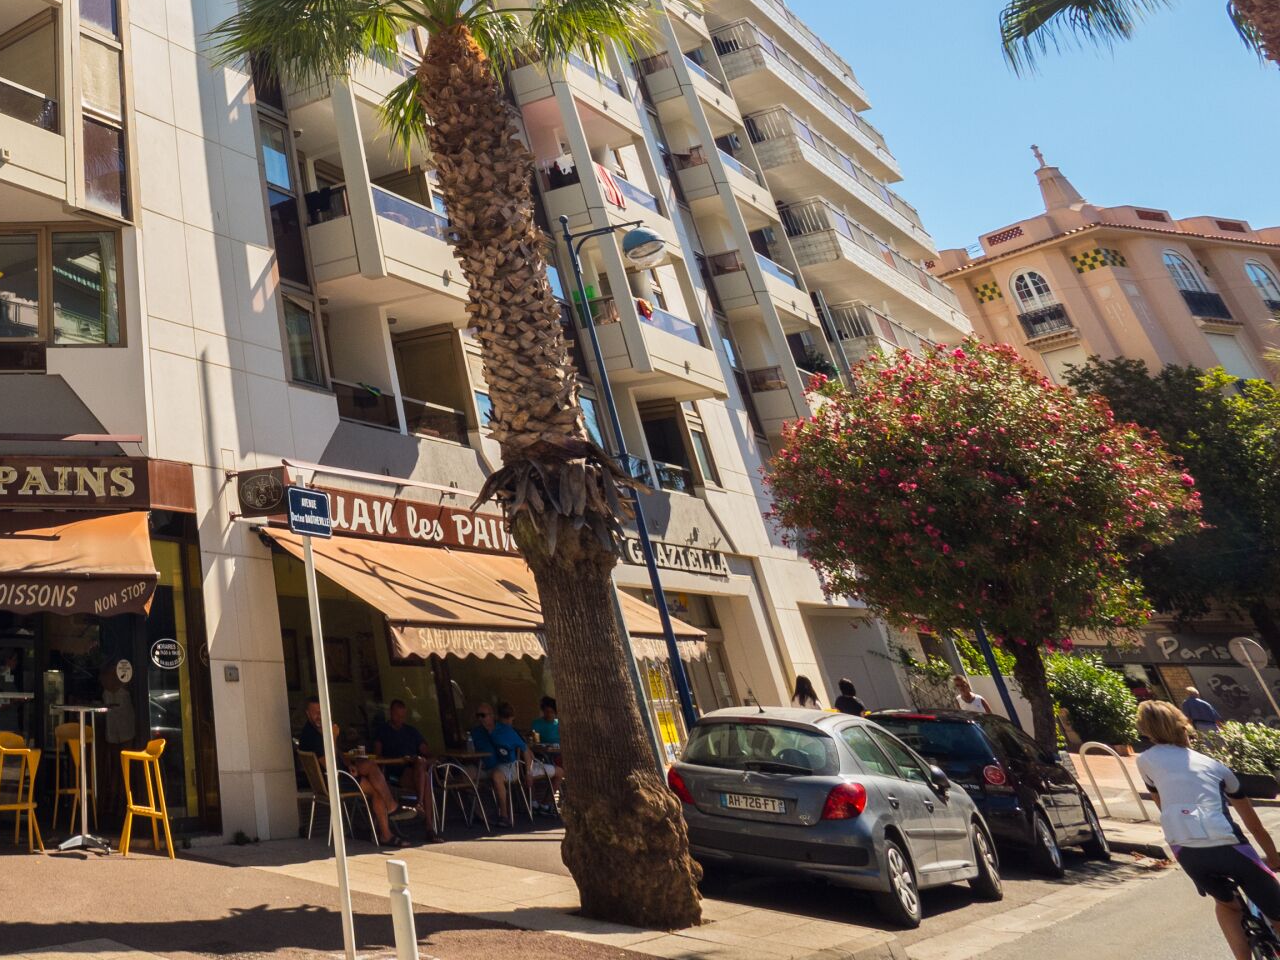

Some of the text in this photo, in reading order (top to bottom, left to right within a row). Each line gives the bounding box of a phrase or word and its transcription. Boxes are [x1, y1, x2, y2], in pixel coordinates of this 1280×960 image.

[327, 493, 397, 534] UAN
[406, 505, 444, 541] les
[627, 539, 732, 577] GAZIELLA
[94, 581, 147, 614] NON STOP
[418, 627, 496, 651] SANDWICHES
[1156, 636, 1231, 661] Paris
[728, 794, 777, 811] AH-726-FT
